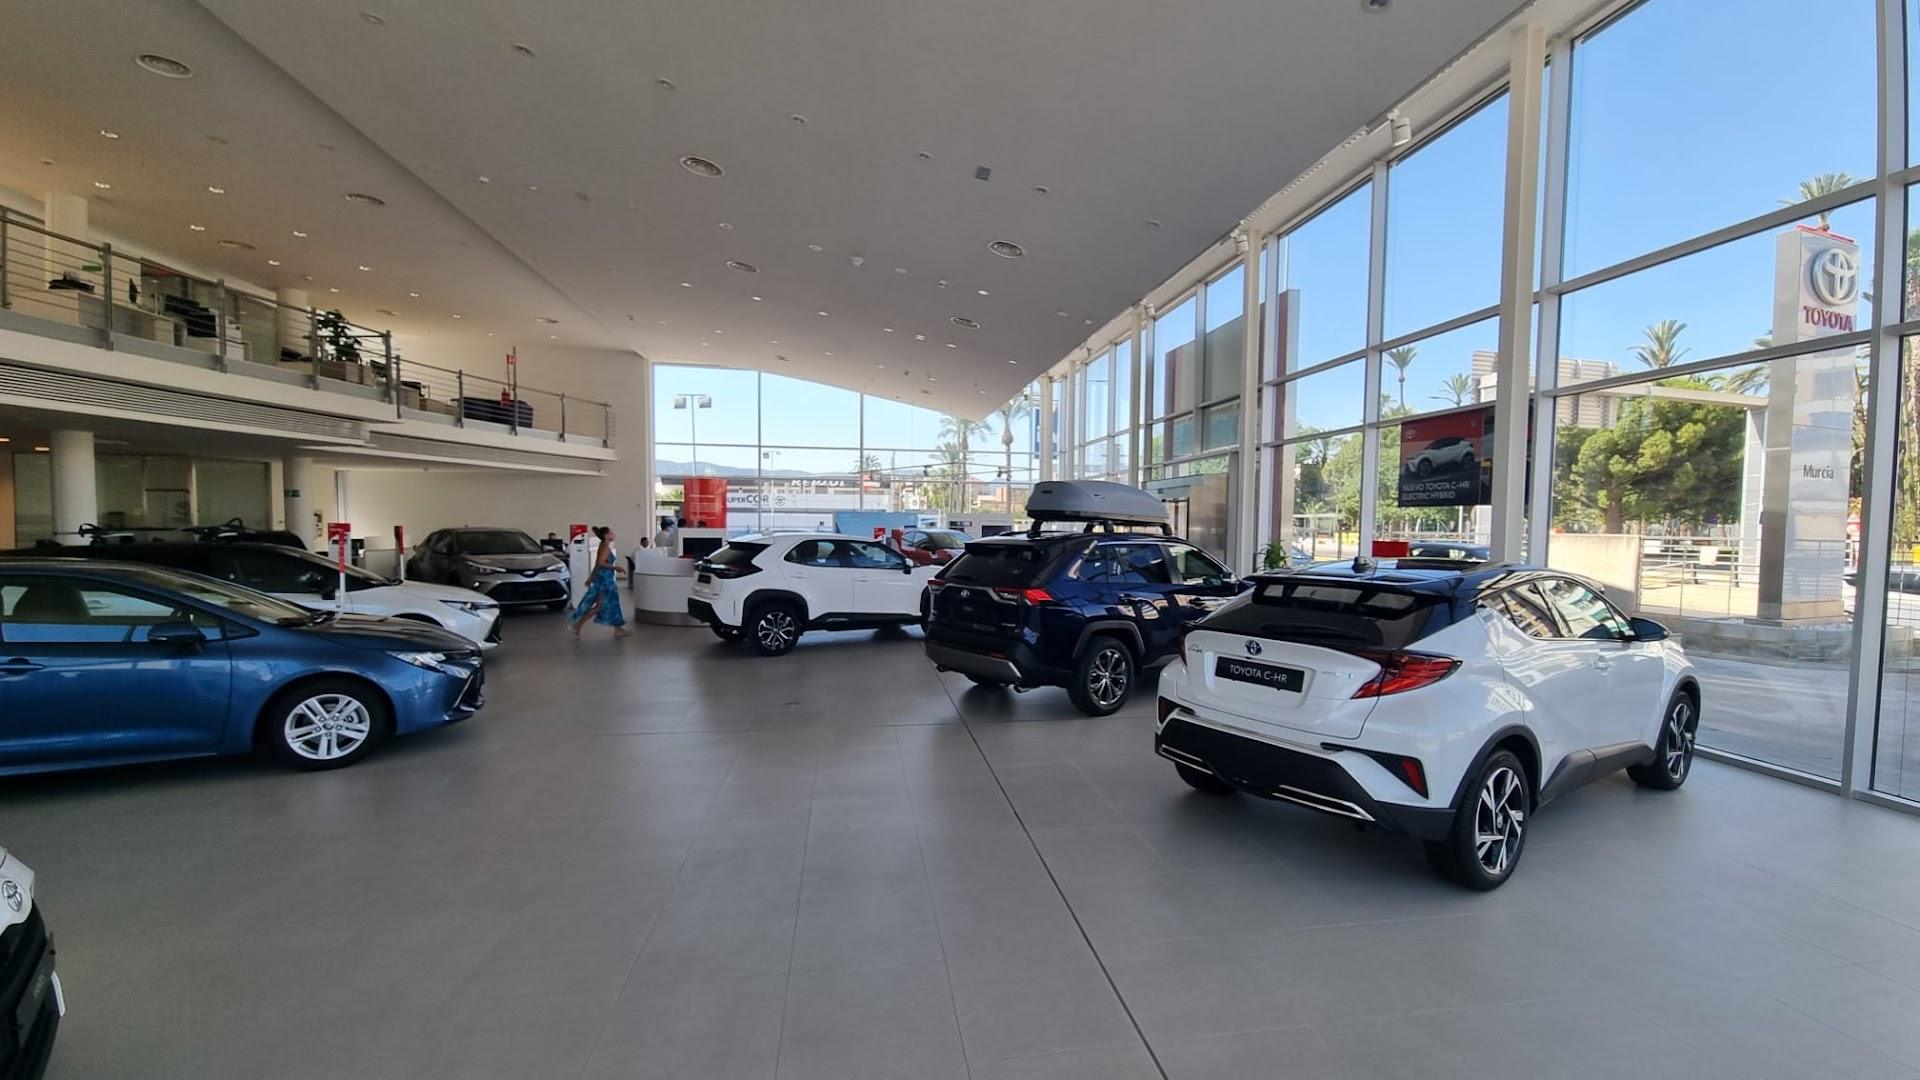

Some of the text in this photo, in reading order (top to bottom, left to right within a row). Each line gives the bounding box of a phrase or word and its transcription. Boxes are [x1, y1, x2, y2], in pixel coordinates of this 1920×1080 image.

[1803, 305, 1853, 332] TOYOTA
[1802, 464, 1834, 479] Murcia
[1402, 480, 1470, 491] NUEVO TOYOTA C-HR
[727, 494, 770, 504] UPERCOR
[1402, 491, 1455, 501] ELECTRIC HYBRID
[1229, 664, 1288, 683] TOYOTA C-HR
